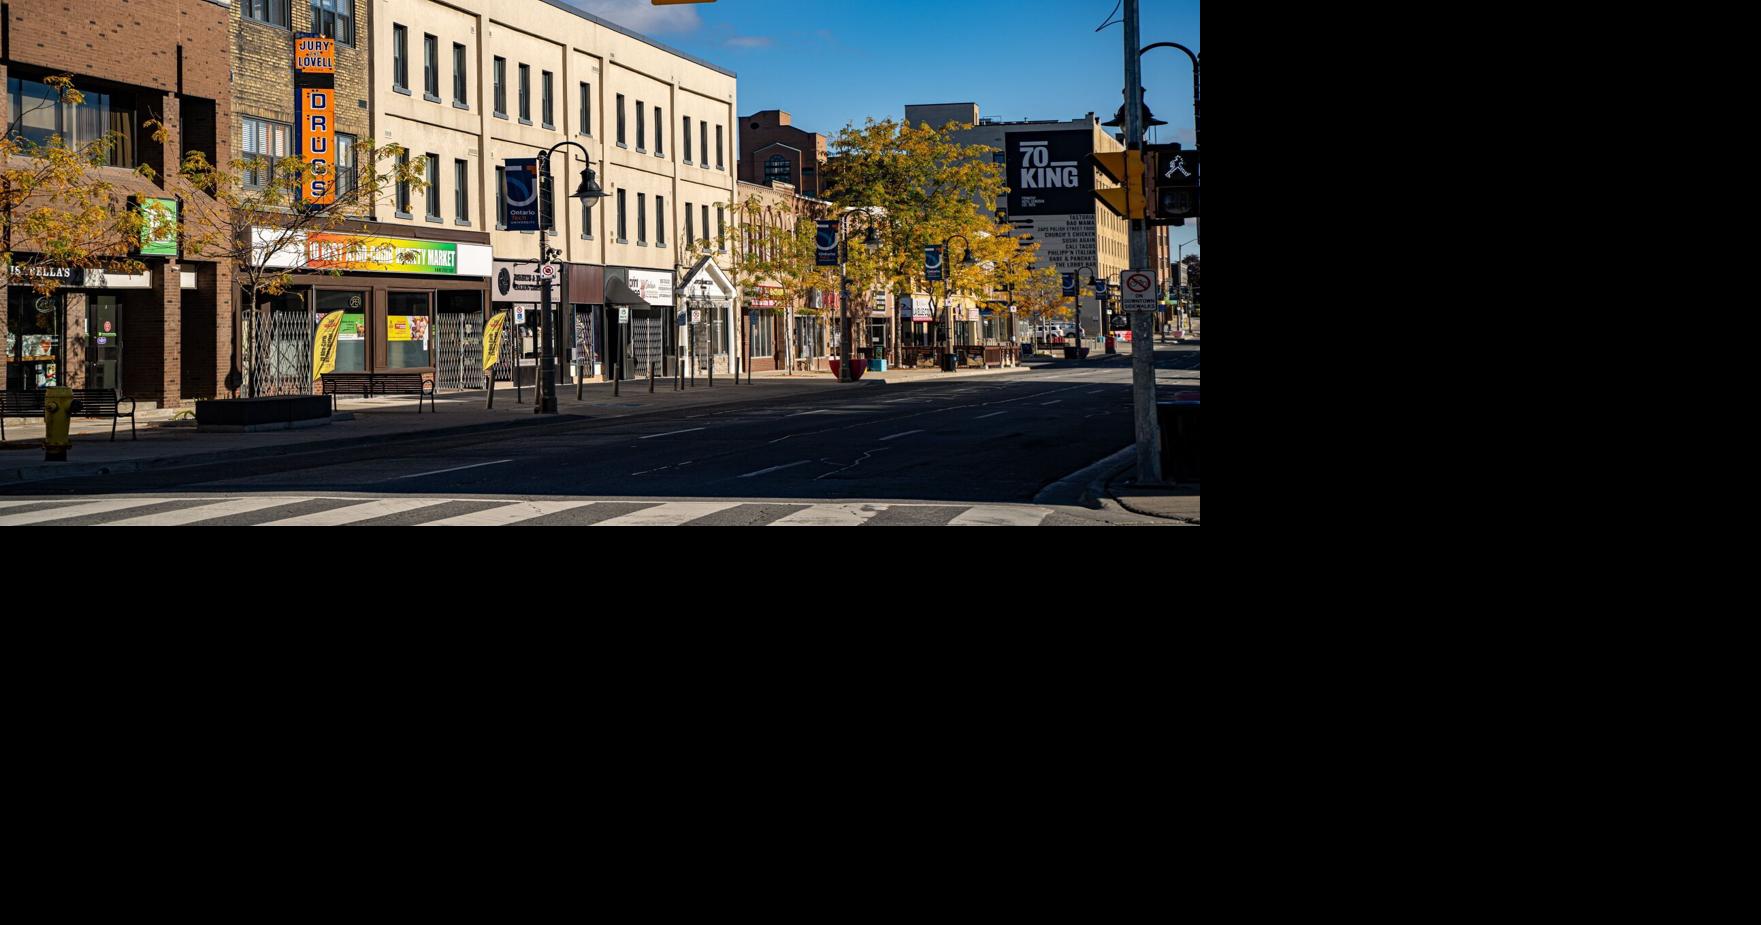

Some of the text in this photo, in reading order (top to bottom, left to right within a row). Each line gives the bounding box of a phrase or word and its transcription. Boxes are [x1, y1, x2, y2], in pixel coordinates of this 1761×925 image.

[300, 40, 330, 51] JURY
[297, 56, 333, 67] LOVELL
[1020, 146, 1048, 168] 70
[1021, 166, 1079, 189] KING
[427, 249, 456, 267] MARKET
